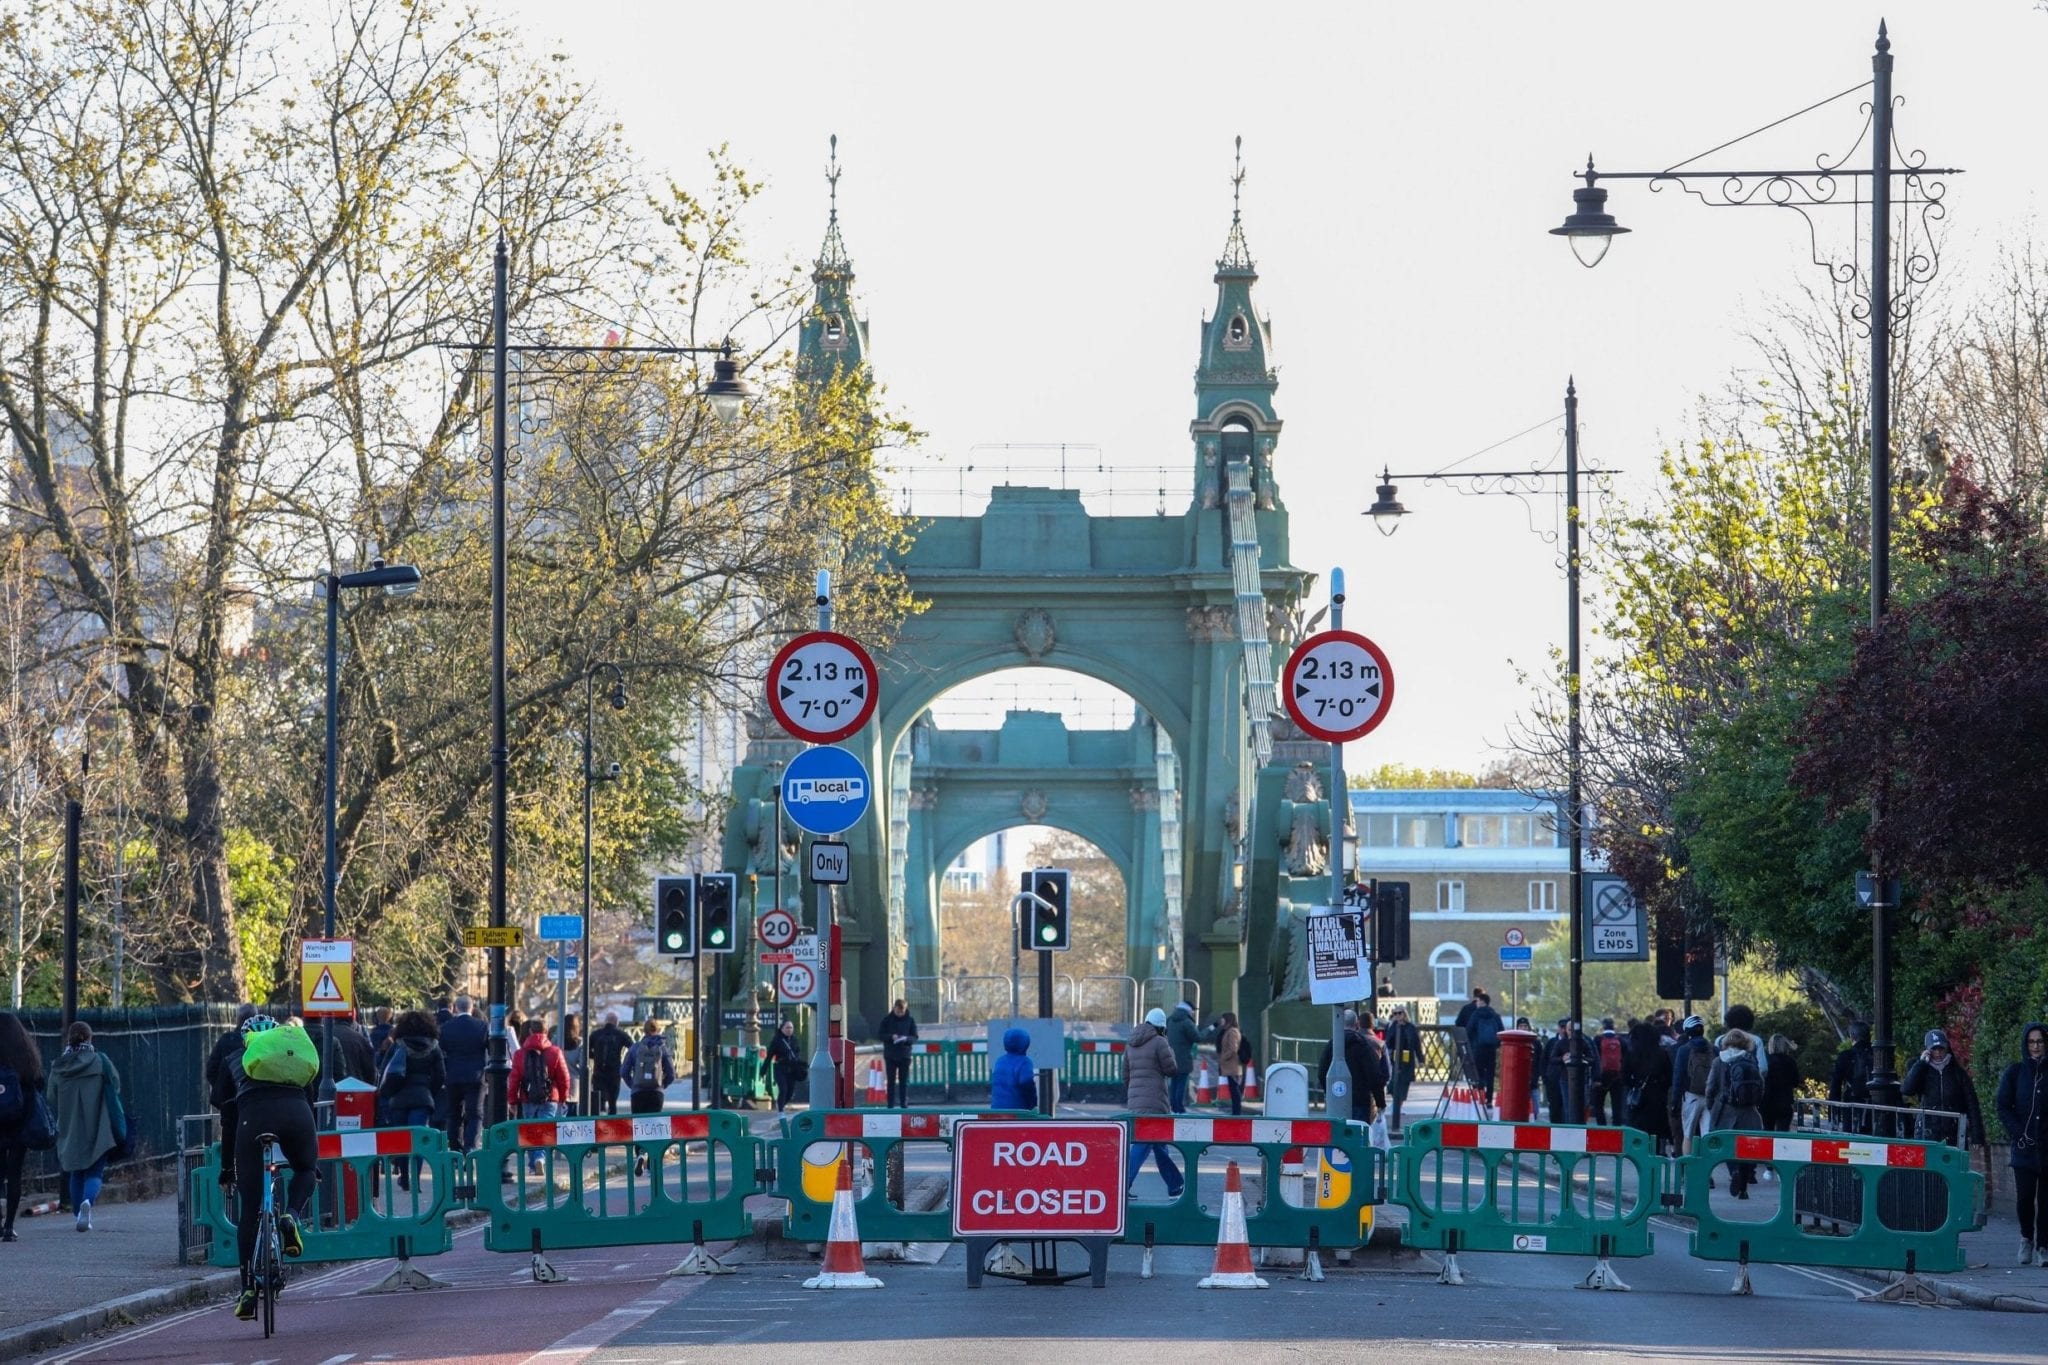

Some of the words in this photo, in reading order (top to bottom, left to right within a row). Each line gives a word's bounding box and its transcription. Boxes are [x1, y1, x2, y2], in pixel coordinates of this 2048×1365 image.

[787, 658, 838, 681] 2.13
[845, 667, 864, 680] m
[1302, 657, 1353, 680] 2.13
[1361, 665, 1379, 679] m
[814, 780, 849, 793] local
[817, 852, 843, 874] Only
[765, 921, 790, 936] 20
[1313, 917, 1342, 930] KARL
[1315, 928, 1346, 941] MARX
[1604, 929, 1627, 937] Zone
[1315, 939, 1355, 952] WALKING
[1598, 940, 1633, 949] ENDS
[1334, 950, 1356, 960] TOUR
[993, 1141, 1088, 1167] ROAD
[972, 1189, 1107, 1215] CLOSED
